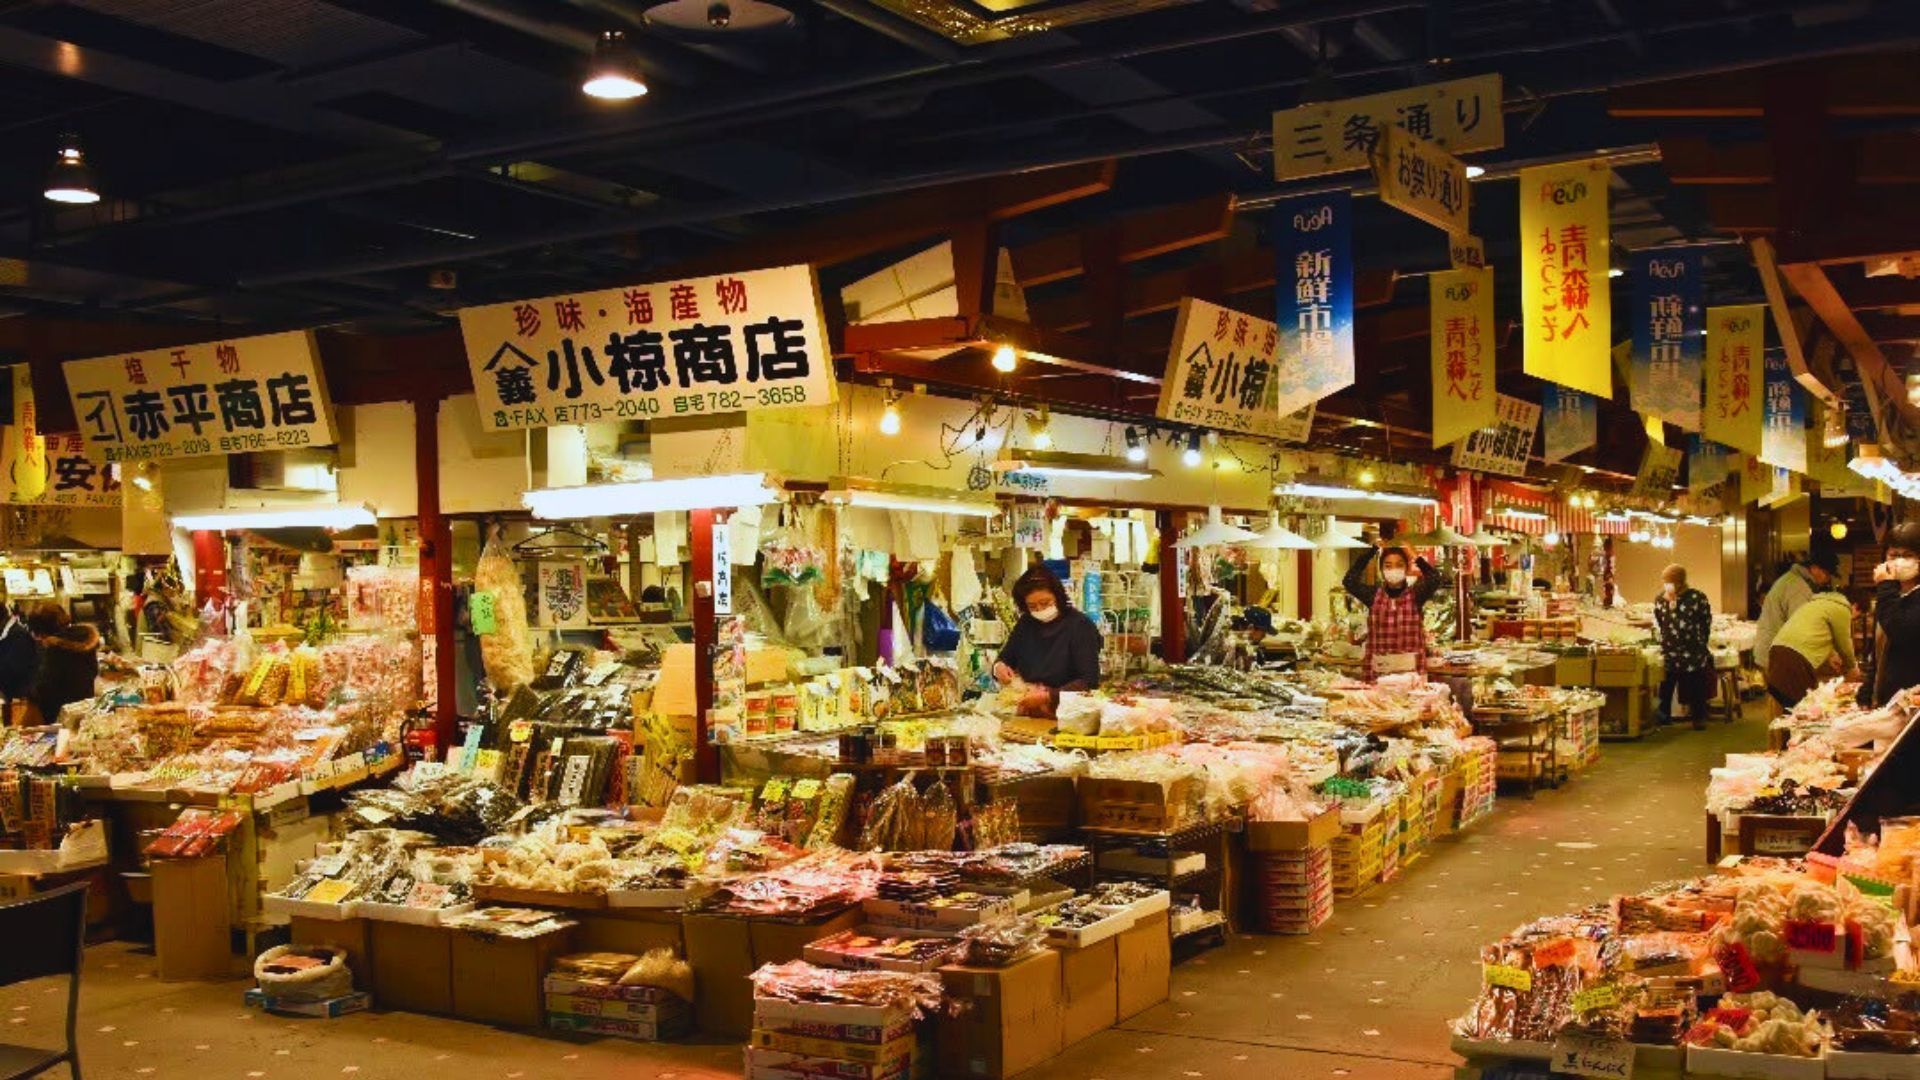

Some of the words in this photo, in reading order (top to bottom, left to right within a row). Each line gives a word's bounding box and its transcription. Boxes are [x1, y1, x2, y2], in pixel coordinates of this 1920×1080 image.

[1293, 95, 1480, 158] 三条通り
[514, 277, 748, 338] 珍味・海産物
[125, 345, 240, 385] 塩干物
[547, 316, 810, 399] 小椋商店
[123, 372, 317, 441] 赤平商店
